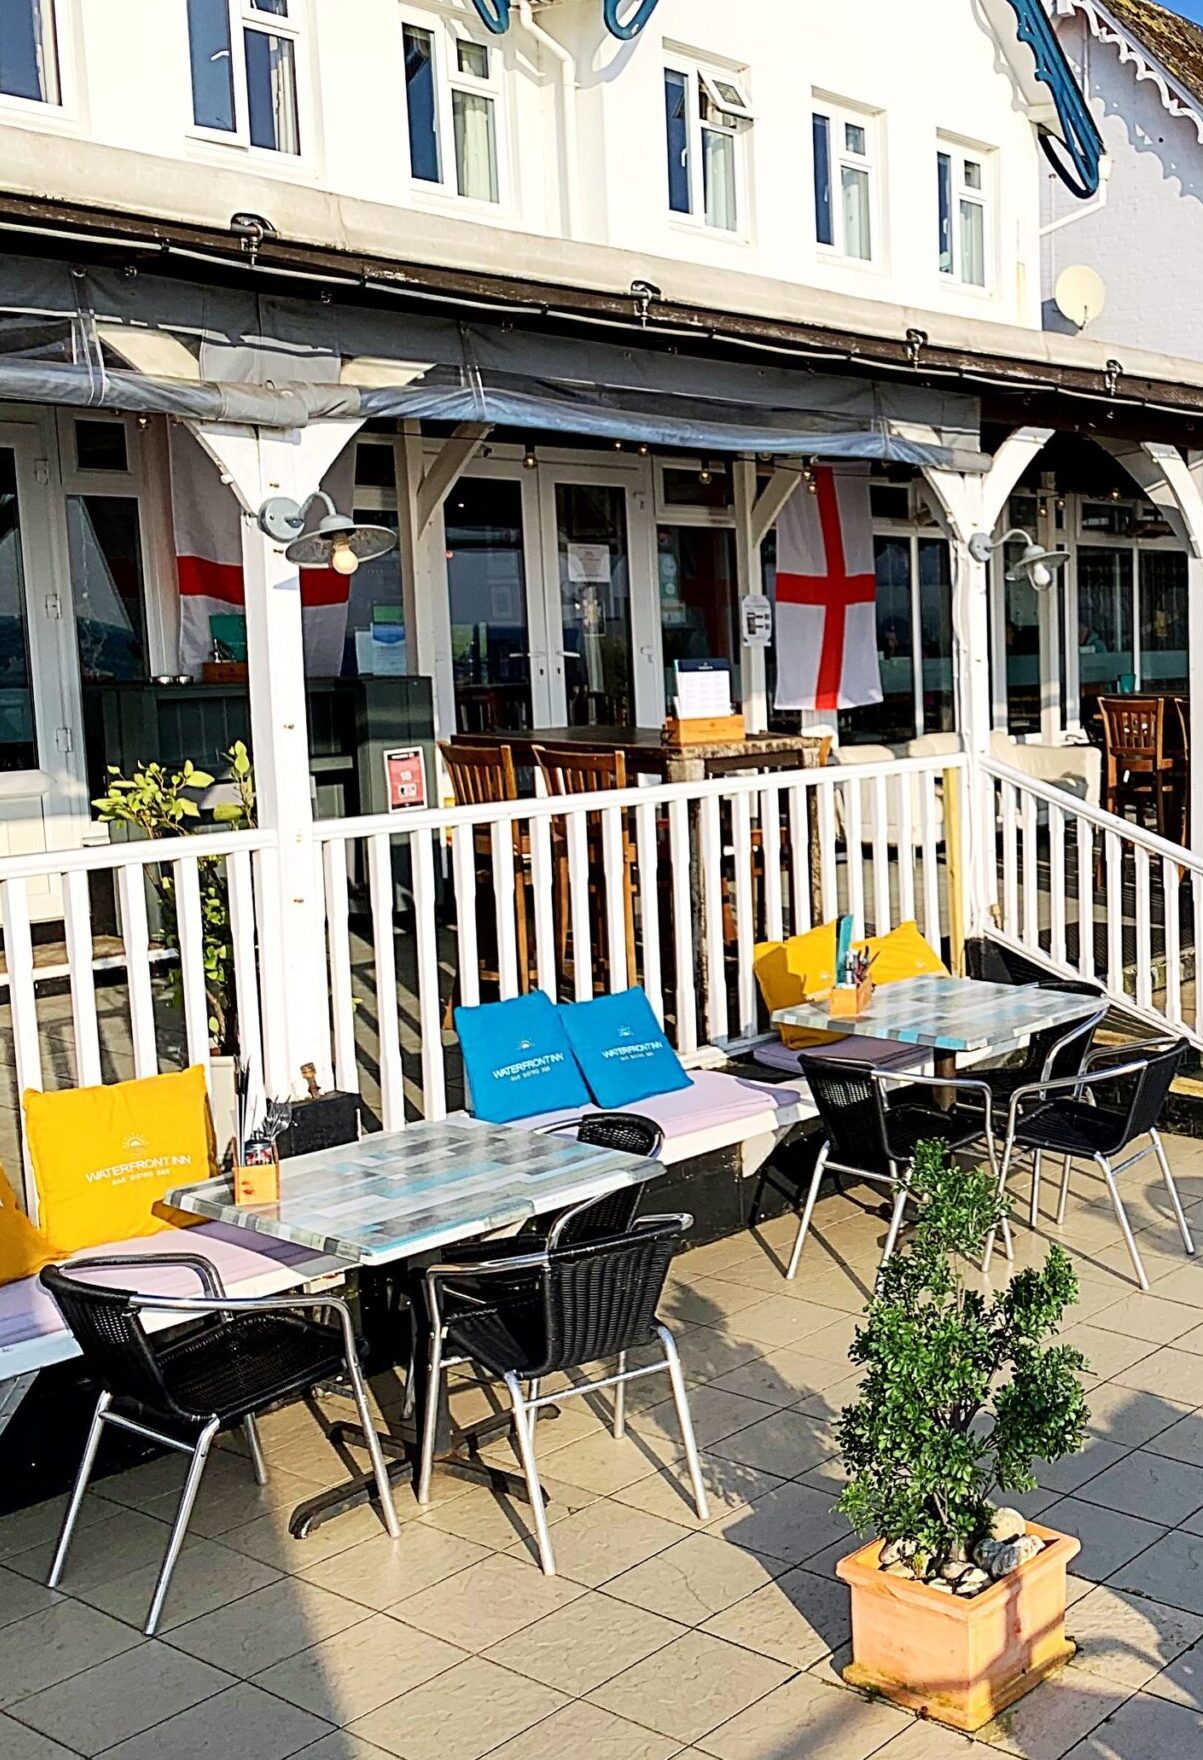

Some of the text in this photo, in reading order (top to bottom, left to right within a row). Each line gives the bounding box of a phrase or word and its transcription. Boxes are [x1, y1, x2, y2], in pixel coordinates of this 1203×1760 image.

[601, 1043, 652, 1058] WATERFRONT
[492, 1055, 551, 1079] WATERFRONT
[85, 1154, 192, 1183] WATERFRONT INN
